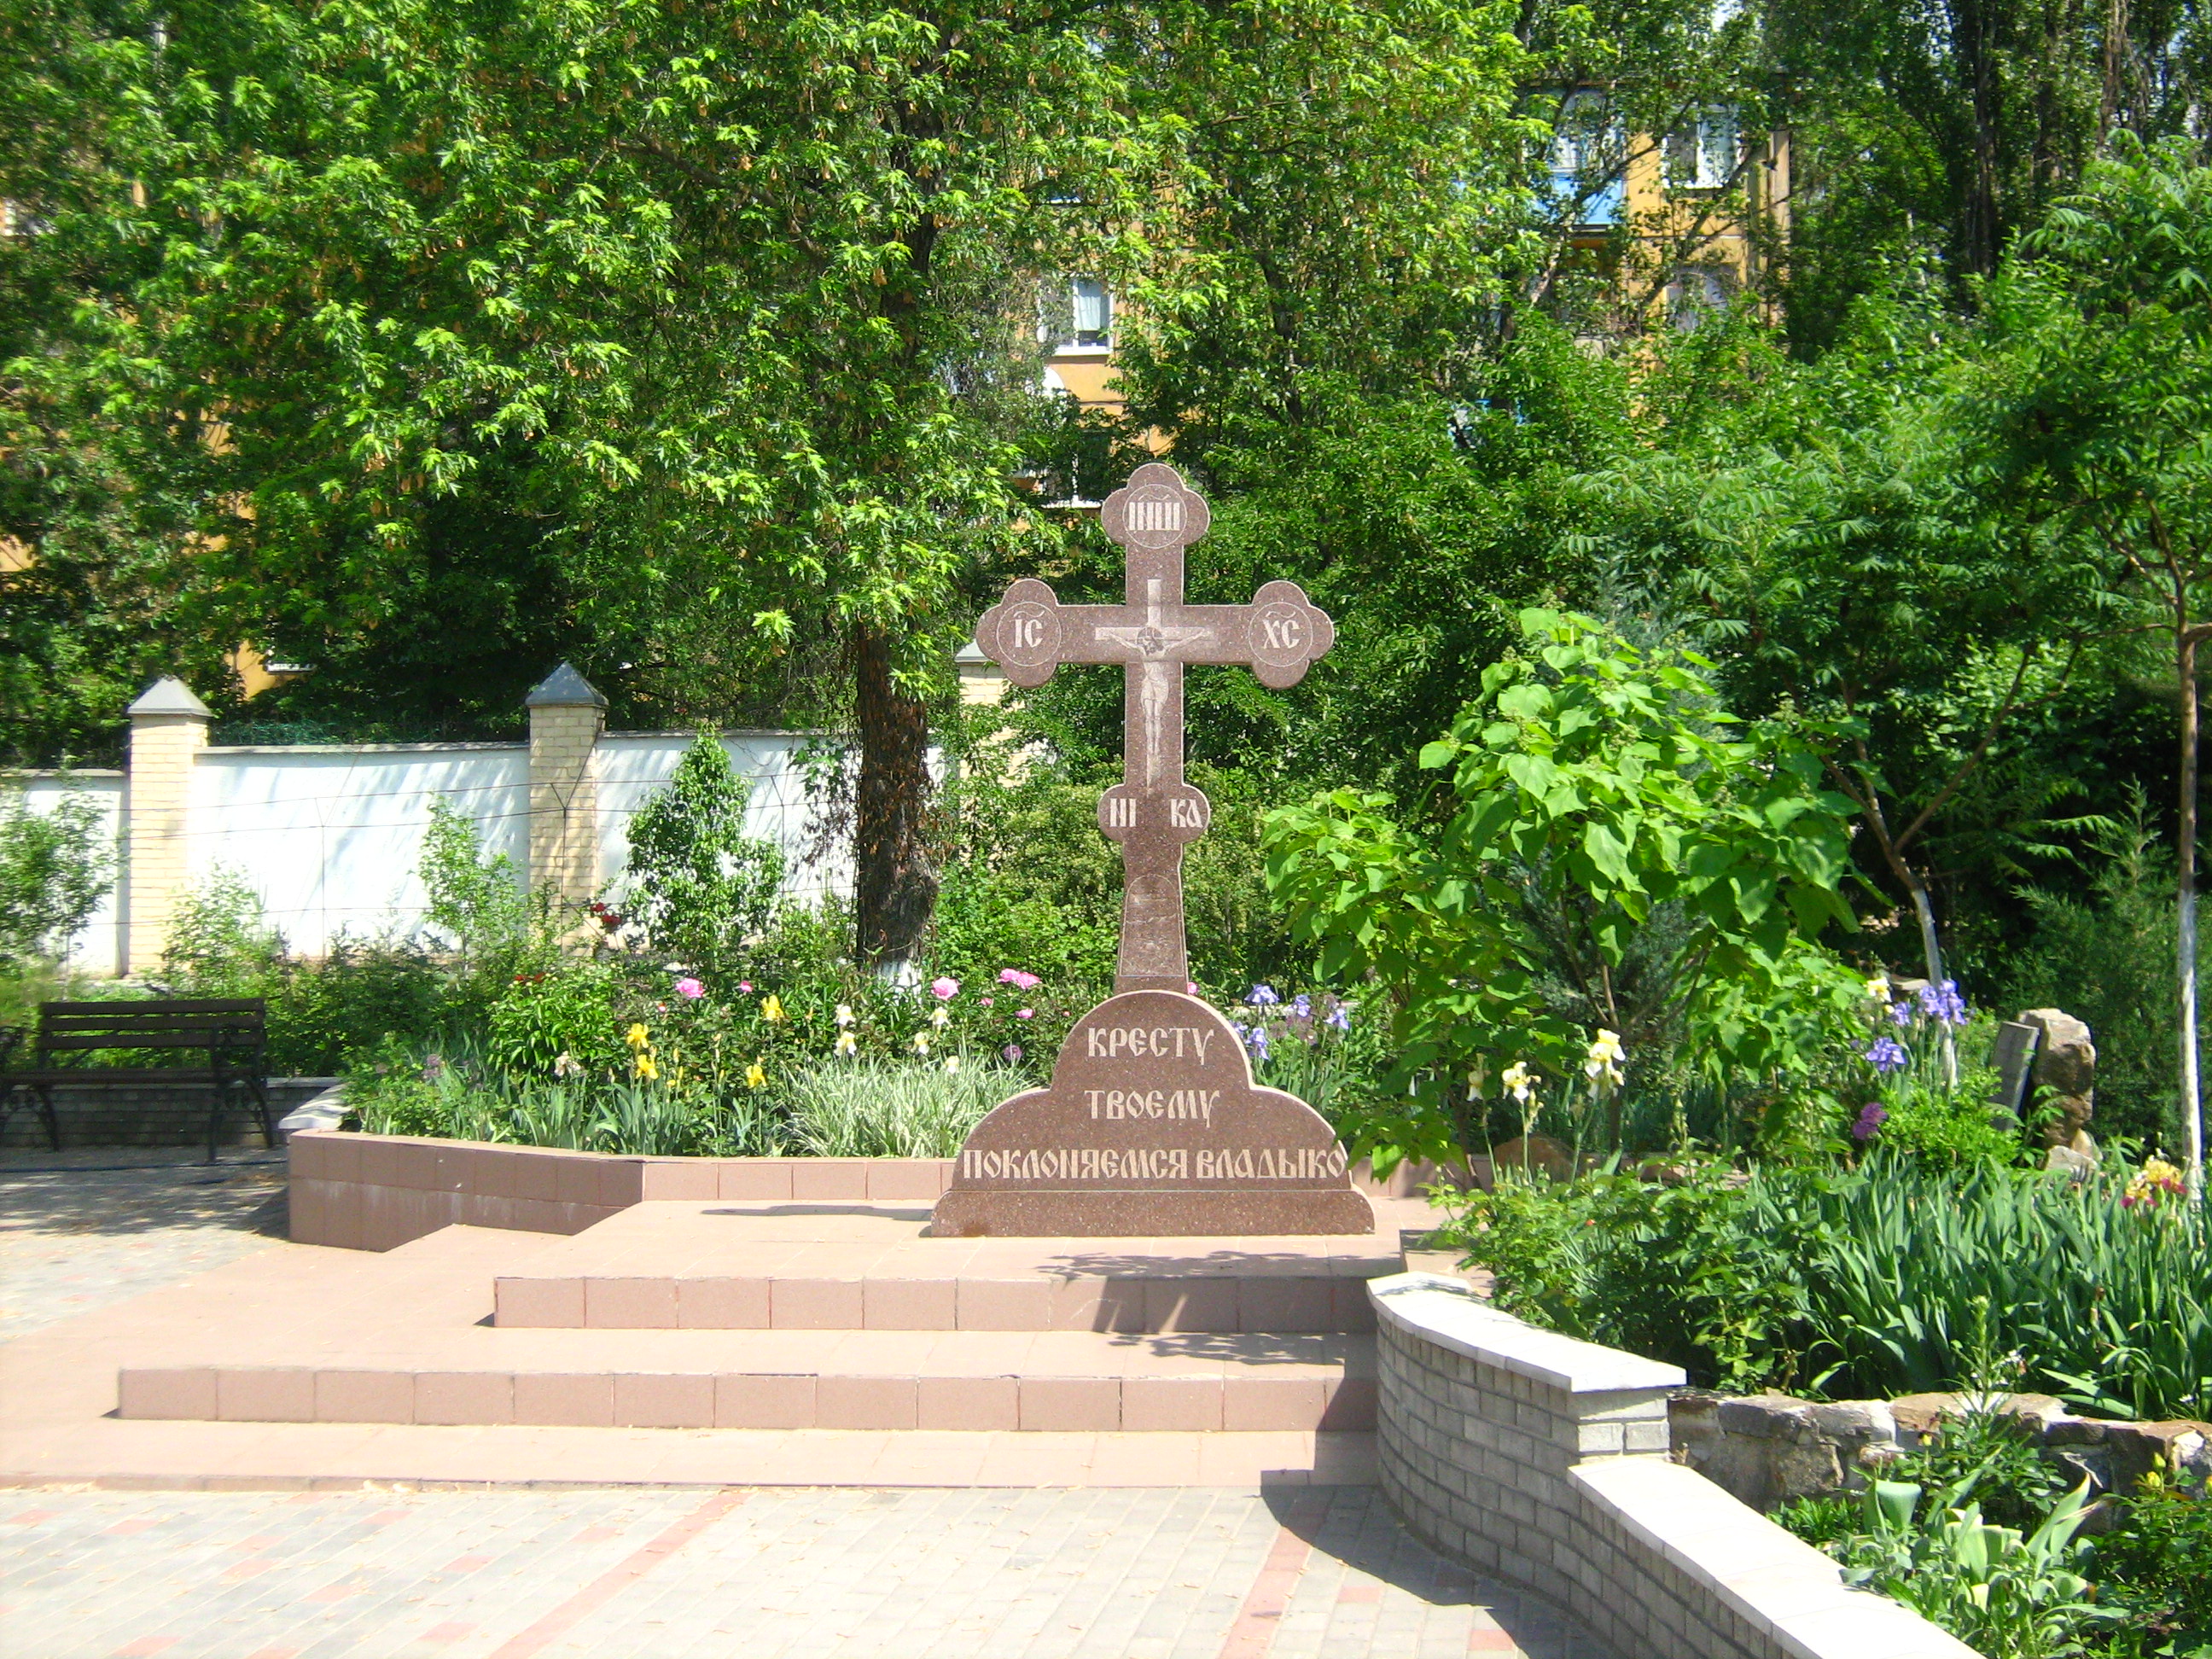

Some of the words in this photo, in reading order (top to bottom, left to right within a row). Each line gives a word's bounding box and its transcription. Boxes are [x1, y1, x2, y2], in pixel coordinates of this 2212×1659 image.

[1087, 1027, 1215, 1066] КРЕСТУ
[1084, 1089, 1220, 1129] ТВОЕМУ
[963, 1149, 1189, 1179] ПОКЛОНЯЕМСЯ
[1196, 1148, 1346, 1179] ВЛАДЫКО
